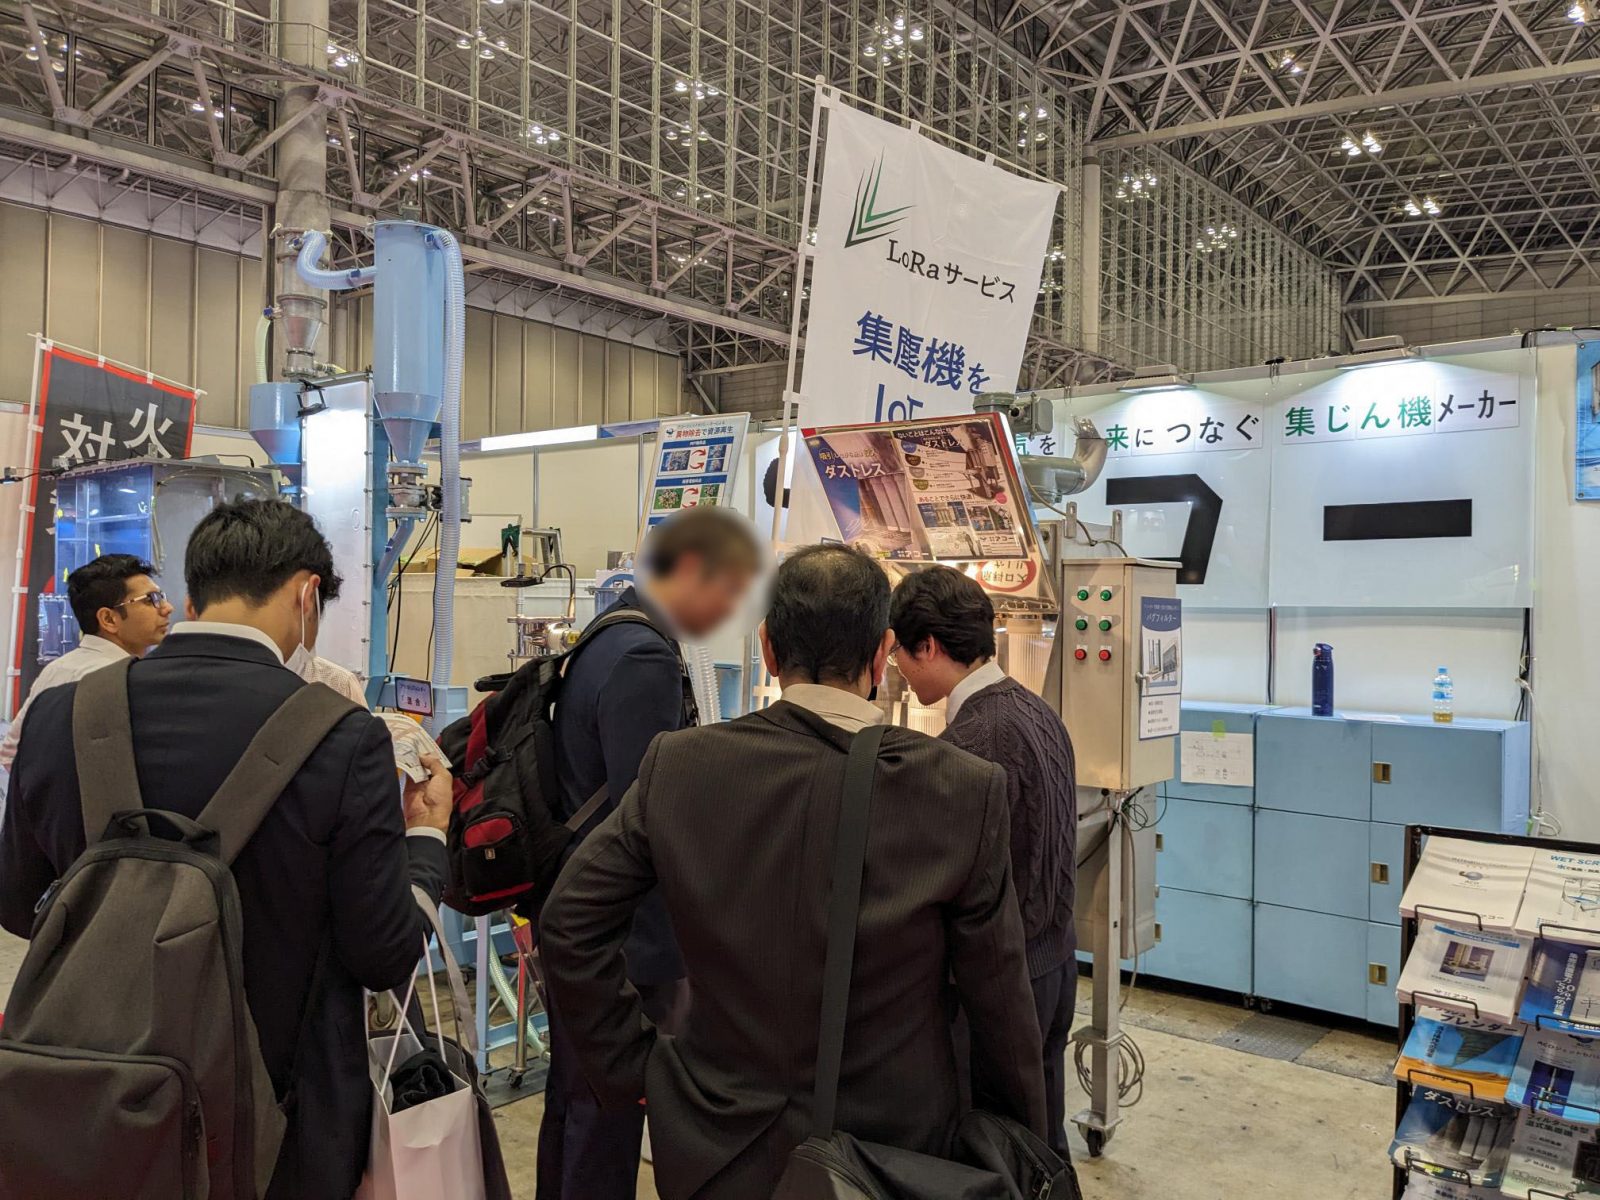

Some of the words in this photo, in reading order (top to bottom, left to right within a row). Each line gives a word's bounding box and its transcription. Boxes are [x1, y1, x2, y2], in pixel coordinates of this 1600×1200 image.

[852, 310, 991, 394] 集塵機を
[124, 402, 173, 459] 火
[1285, 389, 1517, 437] 集じん機メーカー
[825, 462, 886, 479] ダストレス
[1551, 854, 1575, 863] WET
[1423, 1091, 1495, 1117] ダストレス
